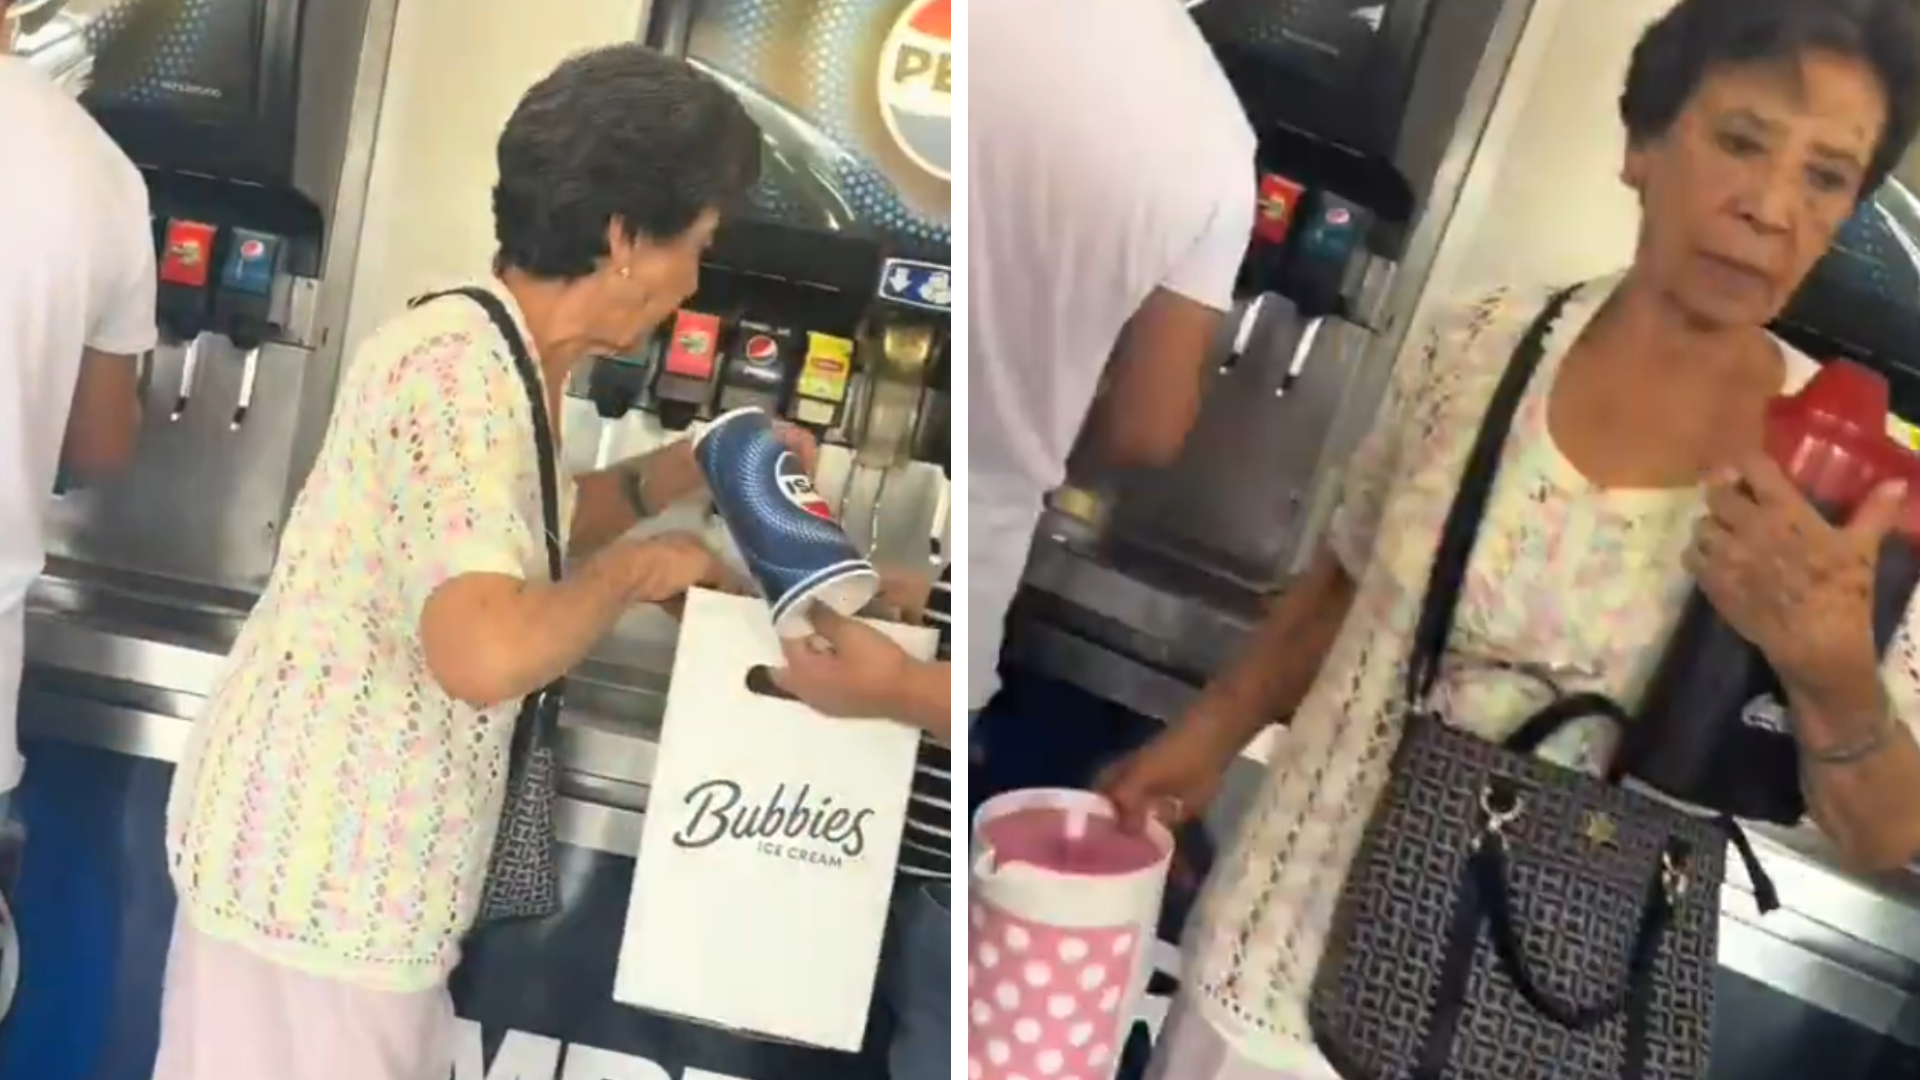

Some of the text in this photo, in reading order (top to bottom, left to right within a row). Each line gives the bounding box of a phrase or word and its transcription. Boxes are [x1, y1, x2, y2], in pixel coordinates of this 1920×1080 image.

[672, 779, 875, 856] Bubbies
[757, 839, 842, 868] ICE CREAM
